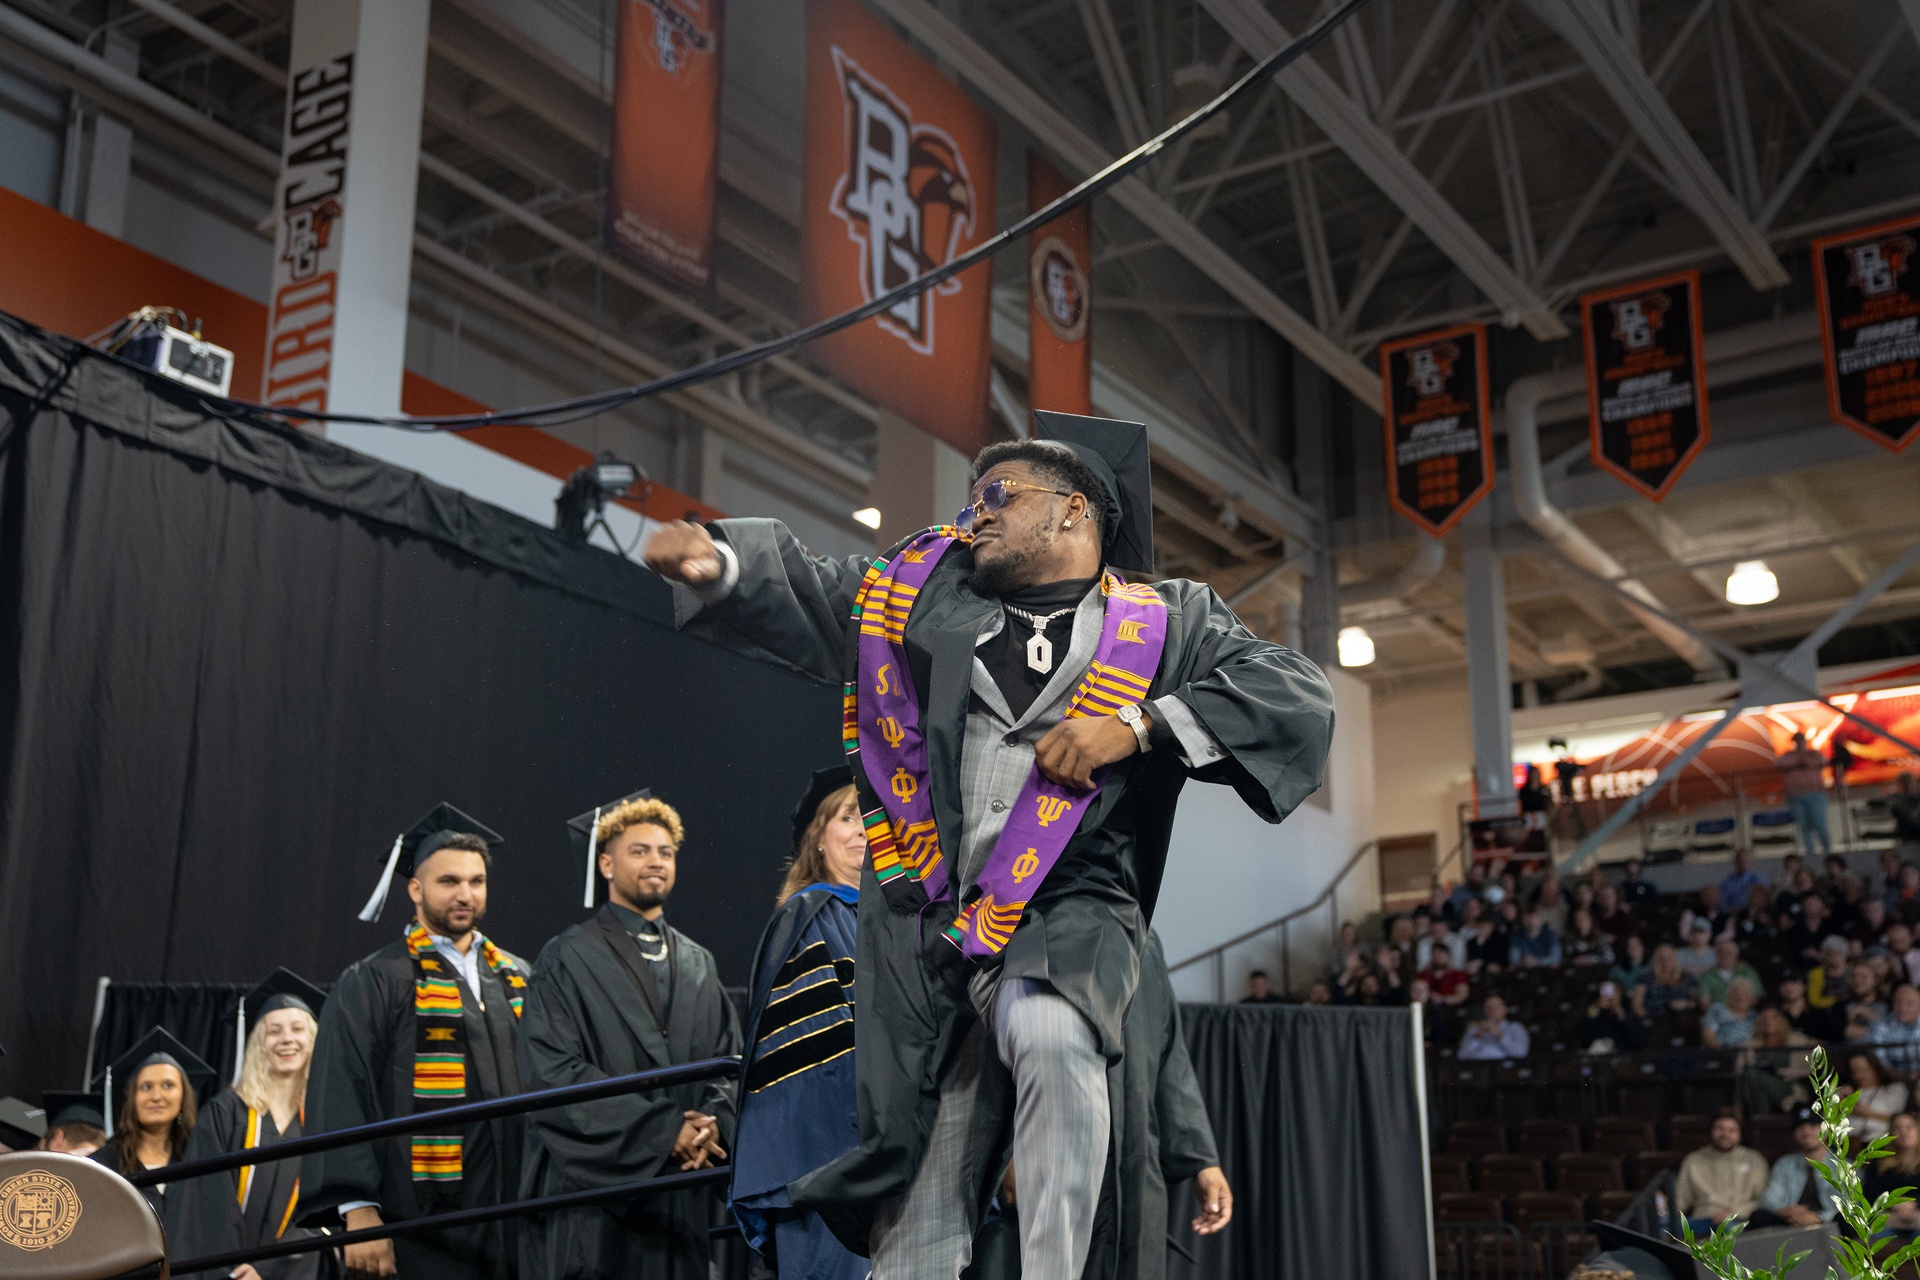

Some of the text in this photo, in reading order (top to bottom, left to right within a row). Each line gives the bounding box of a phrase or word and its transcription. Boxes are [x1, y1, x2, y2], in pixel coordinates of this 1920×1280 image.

[284, 53, 354, 210] CAGE
[1, 1176, 29, 1198] GREEN
[32, 1175, 62, 1187] STATE
[57, 1186, 76, 1236] UNIVERSITY
[22, 1237, 45, 1246] 1910
